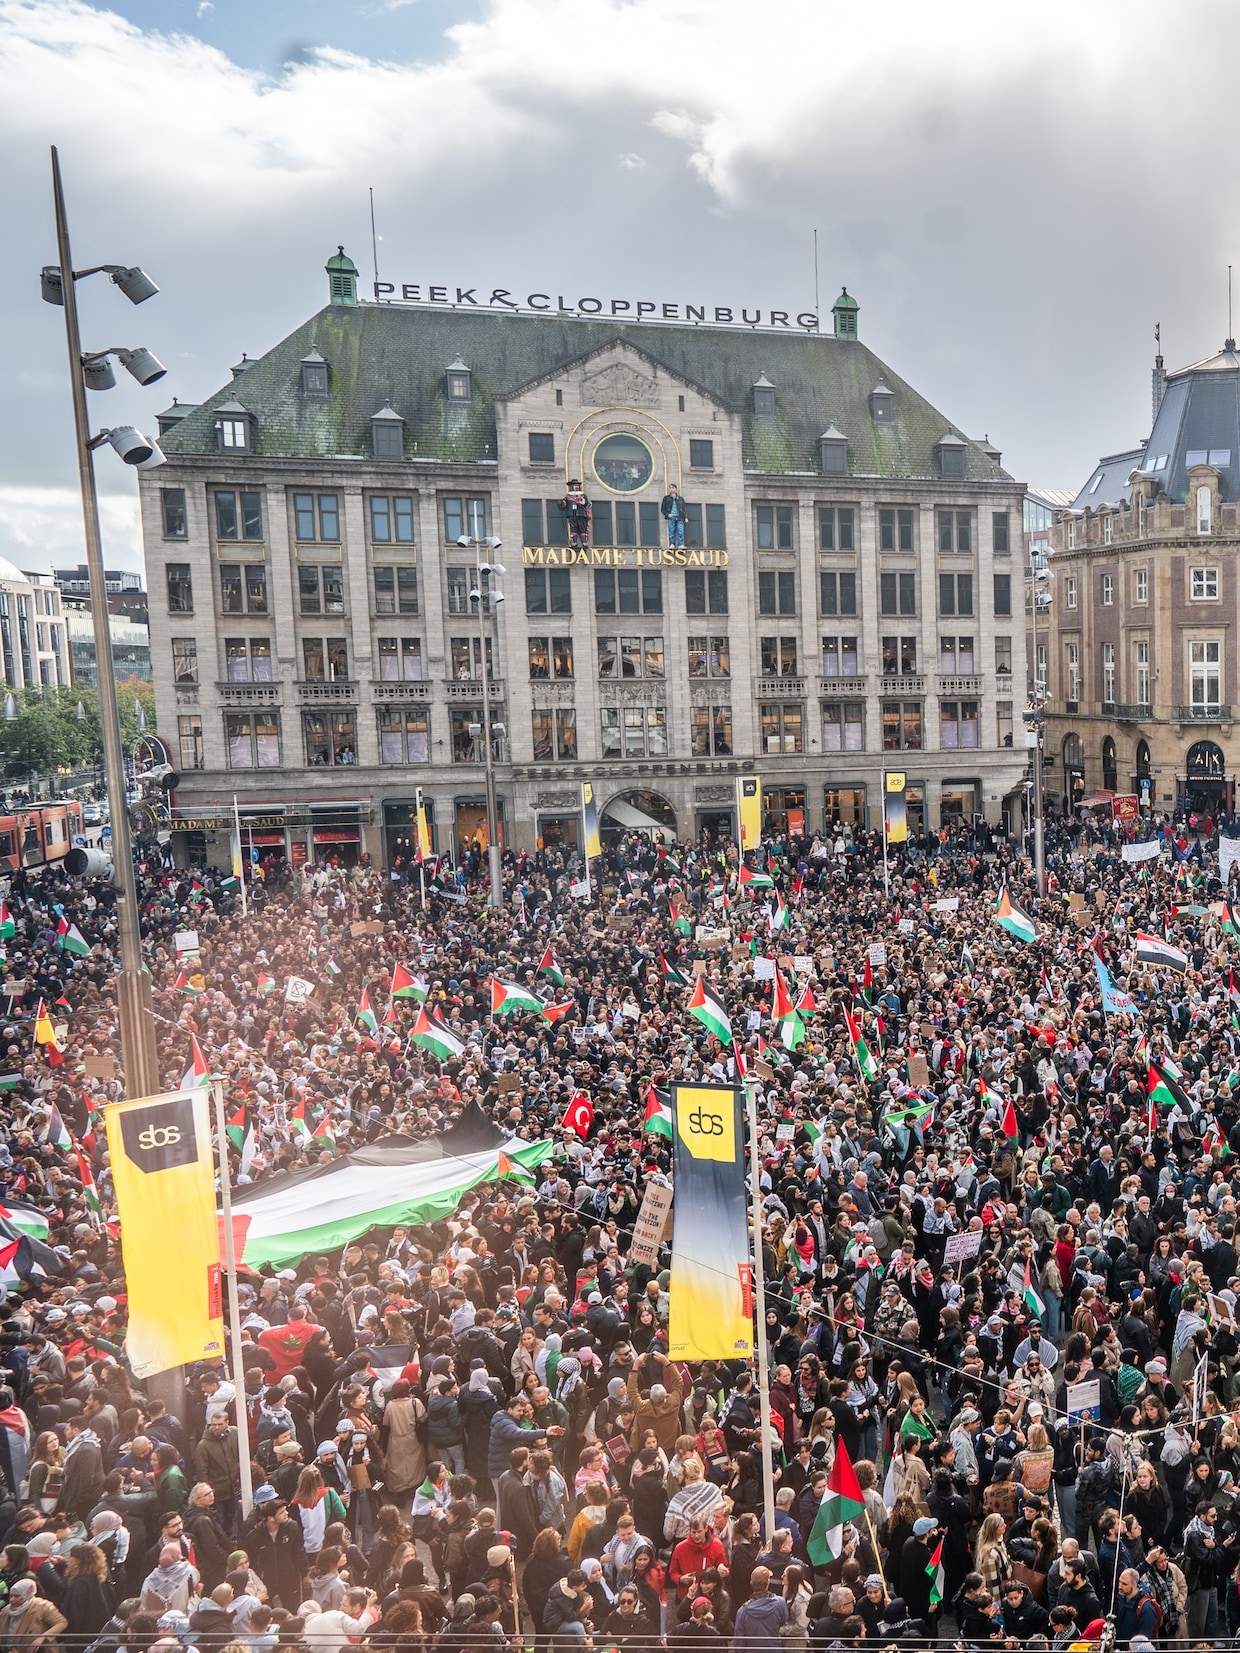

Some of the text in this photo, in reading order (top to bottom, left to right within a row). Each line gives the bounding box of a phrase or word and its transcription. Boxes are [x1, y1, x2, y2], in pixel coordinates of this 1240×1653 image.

[373, 282, 819, 328] PEEK & CLOPPENBURG
[522, 547, 730, 566] MADAME TUSSAUD
[169, 819, 224, 830] MADAME
[648, 1212, 659, 1220] THE
[641, 1231, 657, 1240] BACK!
